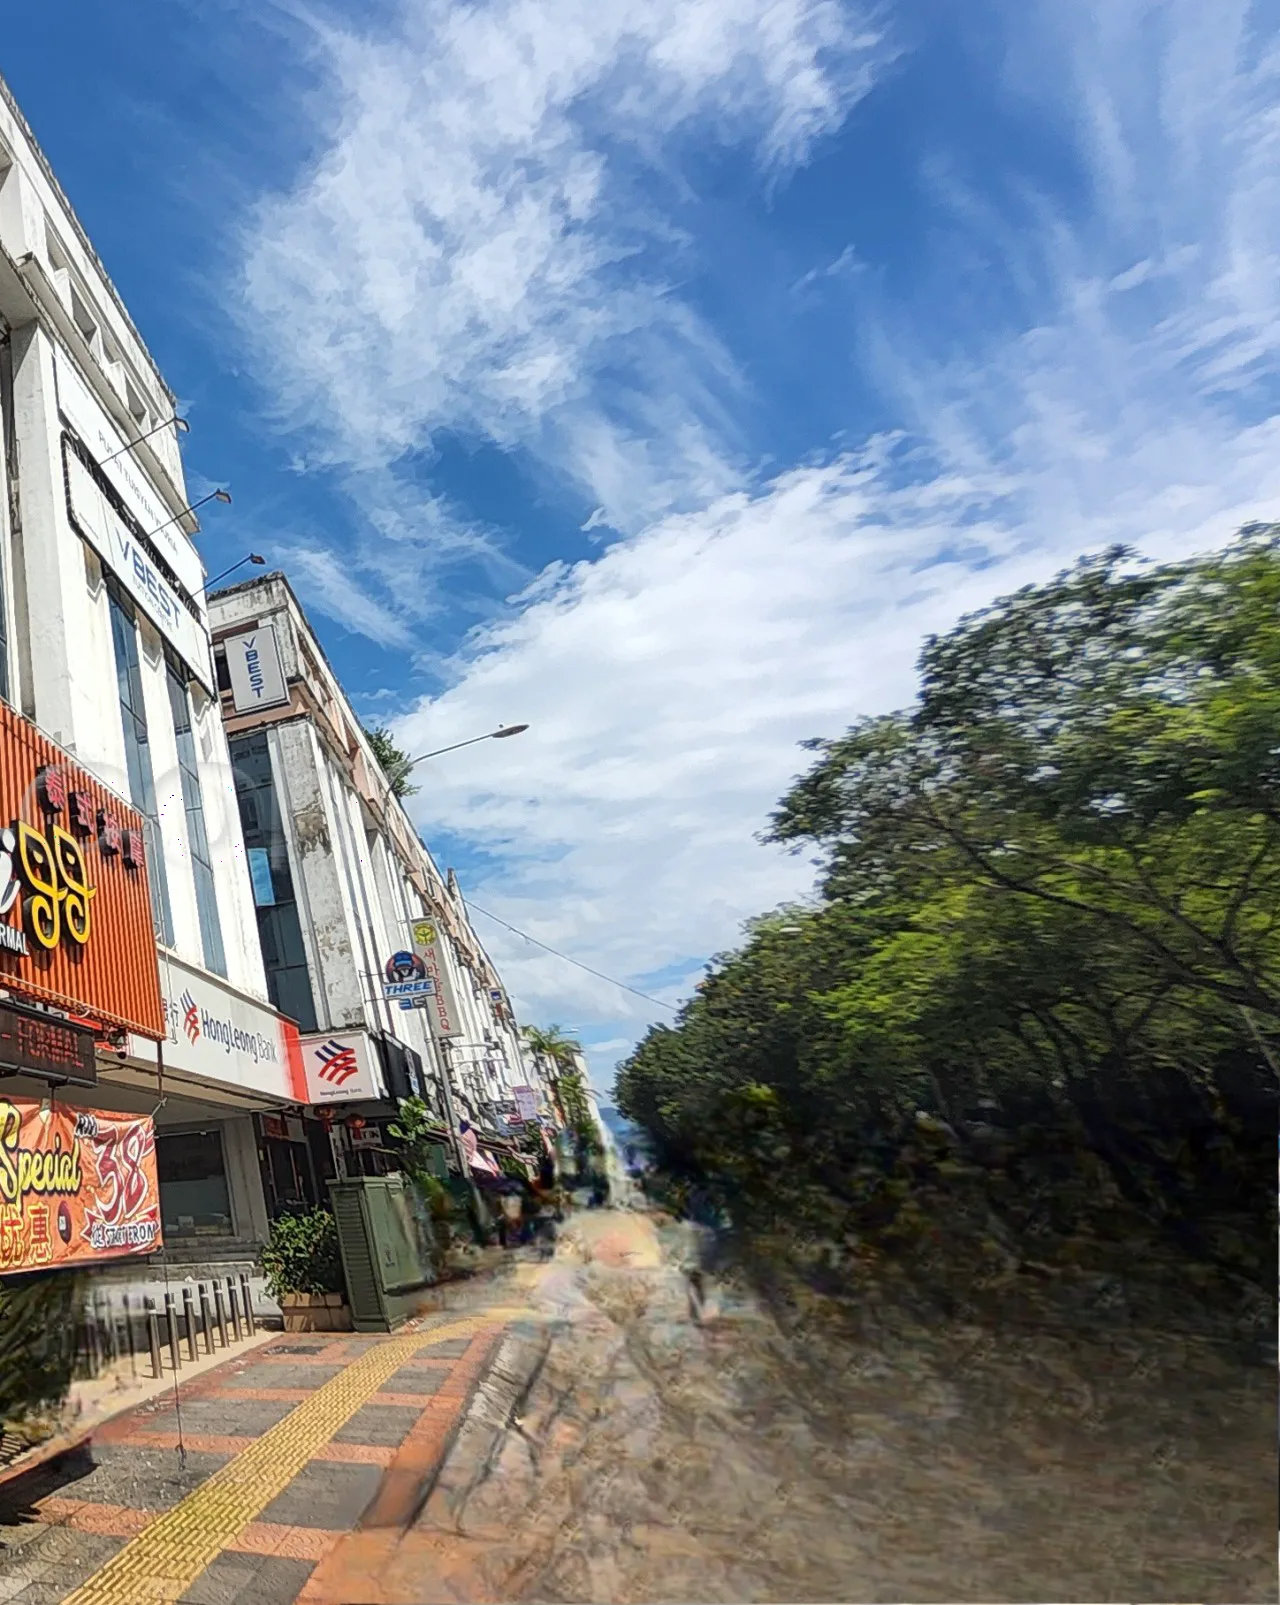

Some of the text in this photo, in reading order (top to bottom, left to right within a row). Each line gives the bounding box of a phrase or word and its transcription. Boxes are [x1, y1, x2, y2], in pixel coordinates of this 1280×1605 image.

[114, 525, 181, 630] VBEST
[242, 634, 265, 699] VBEST
[384, 980, 433, 996] THREE
[200, 1008, 279, 1064] HongLeong Bank
[92, 1122, 149, 1225] 38
